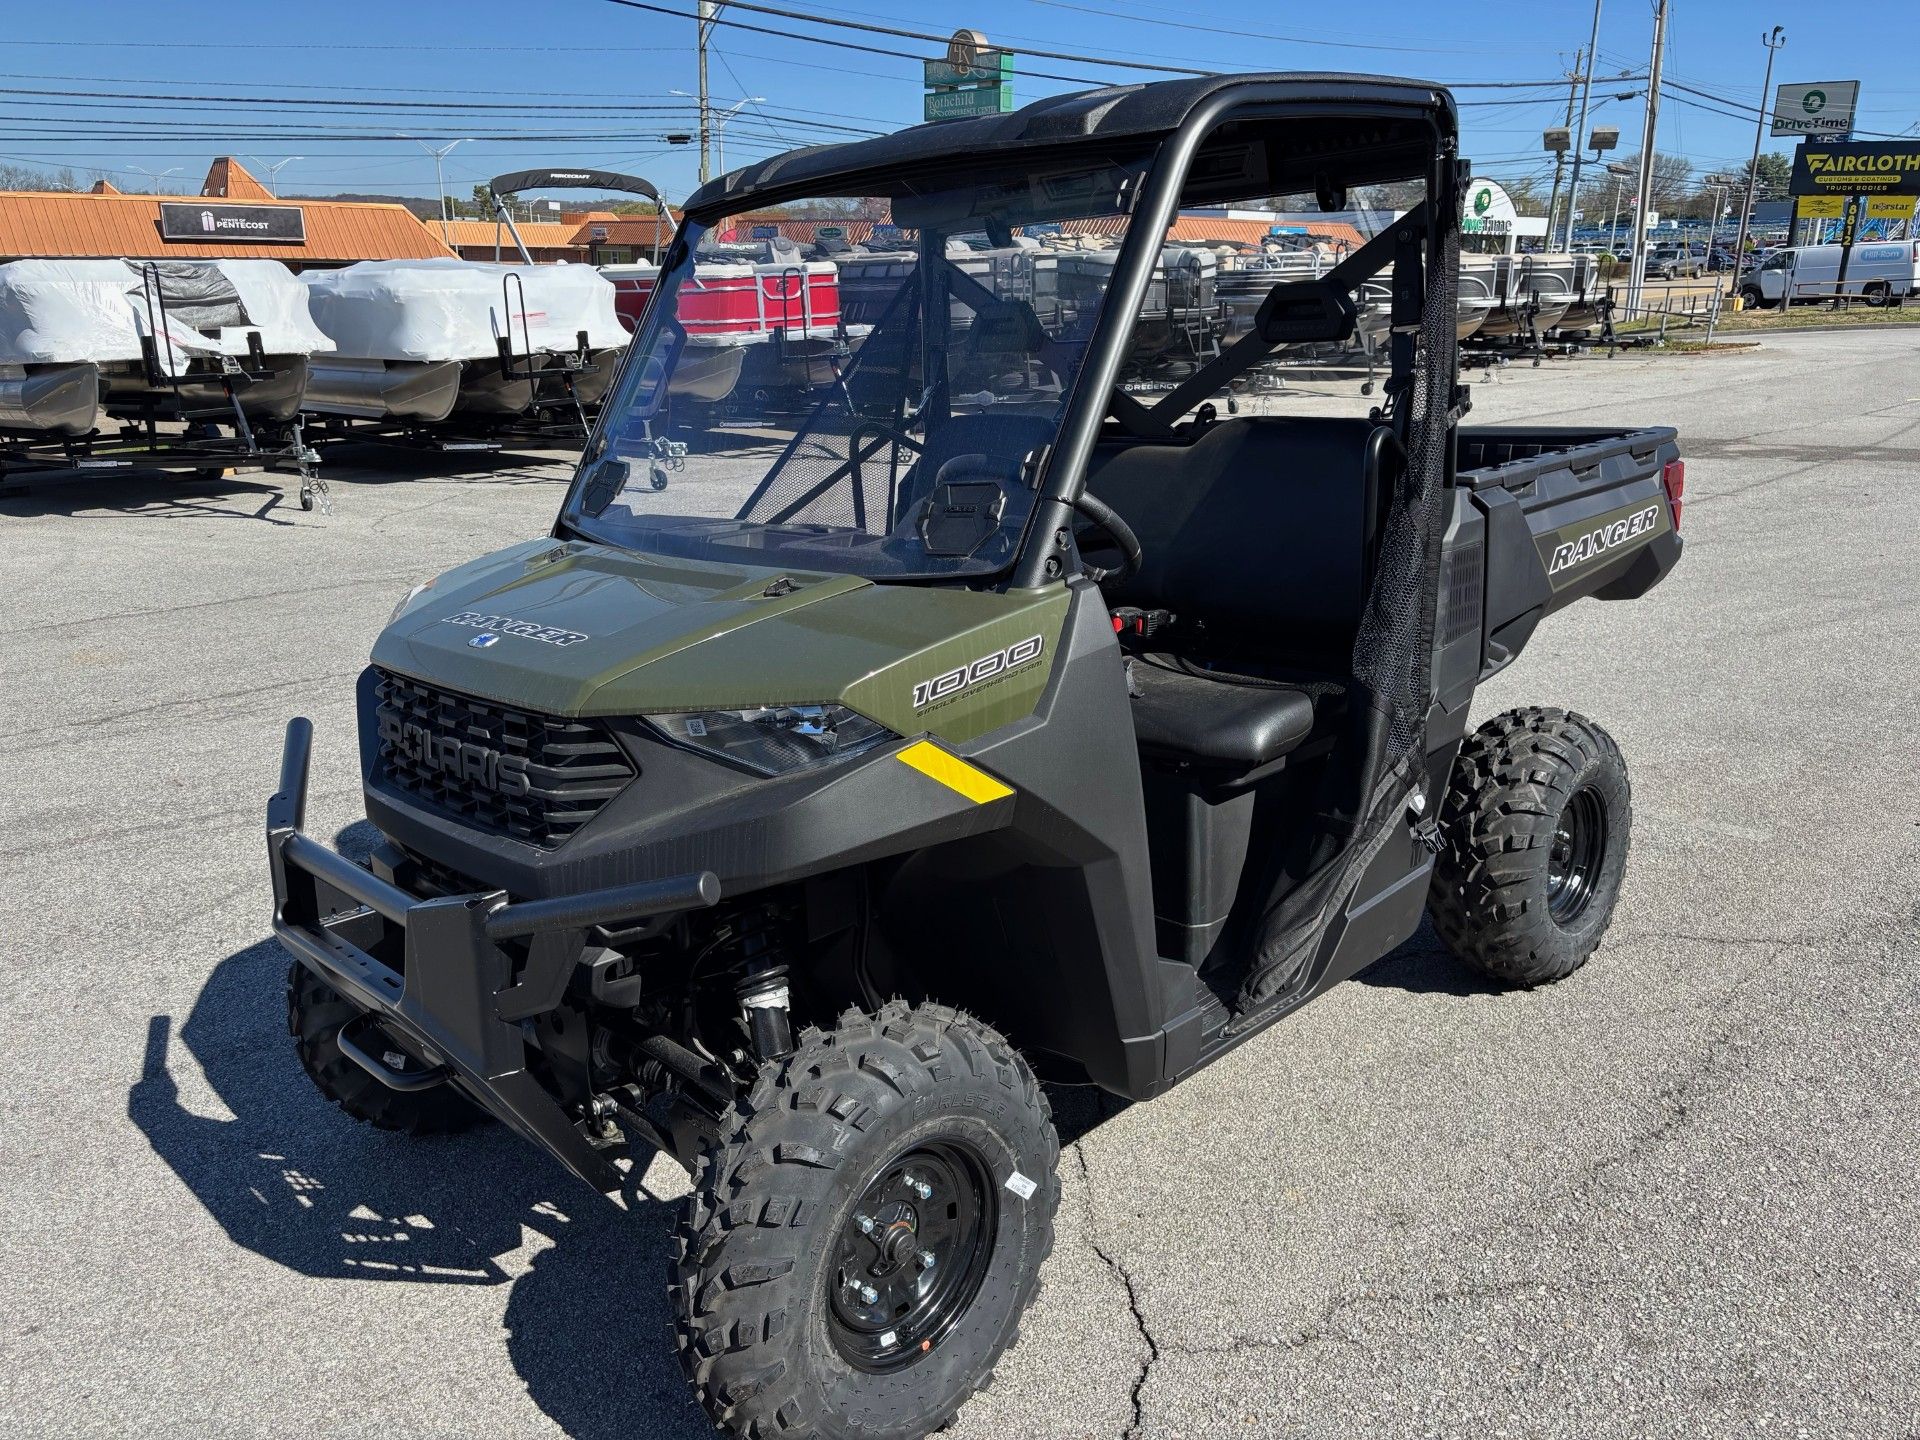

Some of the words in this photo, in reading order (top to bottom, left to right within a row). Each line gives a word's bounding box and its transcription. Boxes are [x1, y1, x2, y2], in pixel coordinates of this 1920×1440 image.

[929, 92, 974, 109] Rothchild
[944, 107, 977, 117] CONFERENCE
[977, 105, 998, 114] CENTER
[1774, 117, 1848, 130] DriveTime
[1805, 154, 1920, 174] FAIRCLOTH
[216, 221, 269, 230] PENTECOST
[1462, 213, 1512, 232] iveTime
[1842, 204, 1858, 246] 8812
[1864, 249, 1900, 258] Hill-Rom
[1133, 383, 1179, 391] REGENCY
[1549, 505, 1659, 575] RANGER
[441, 612, 589, 647] RANGER
[913, 634, 1045, 708] 1000
[916, 695, 959, 718] SINGLE
[960, 670, 1019, 700] OVERHEAD
[1020, 660, 1043, 675] CAM
[378, 713, 531, 798] POLARIS
